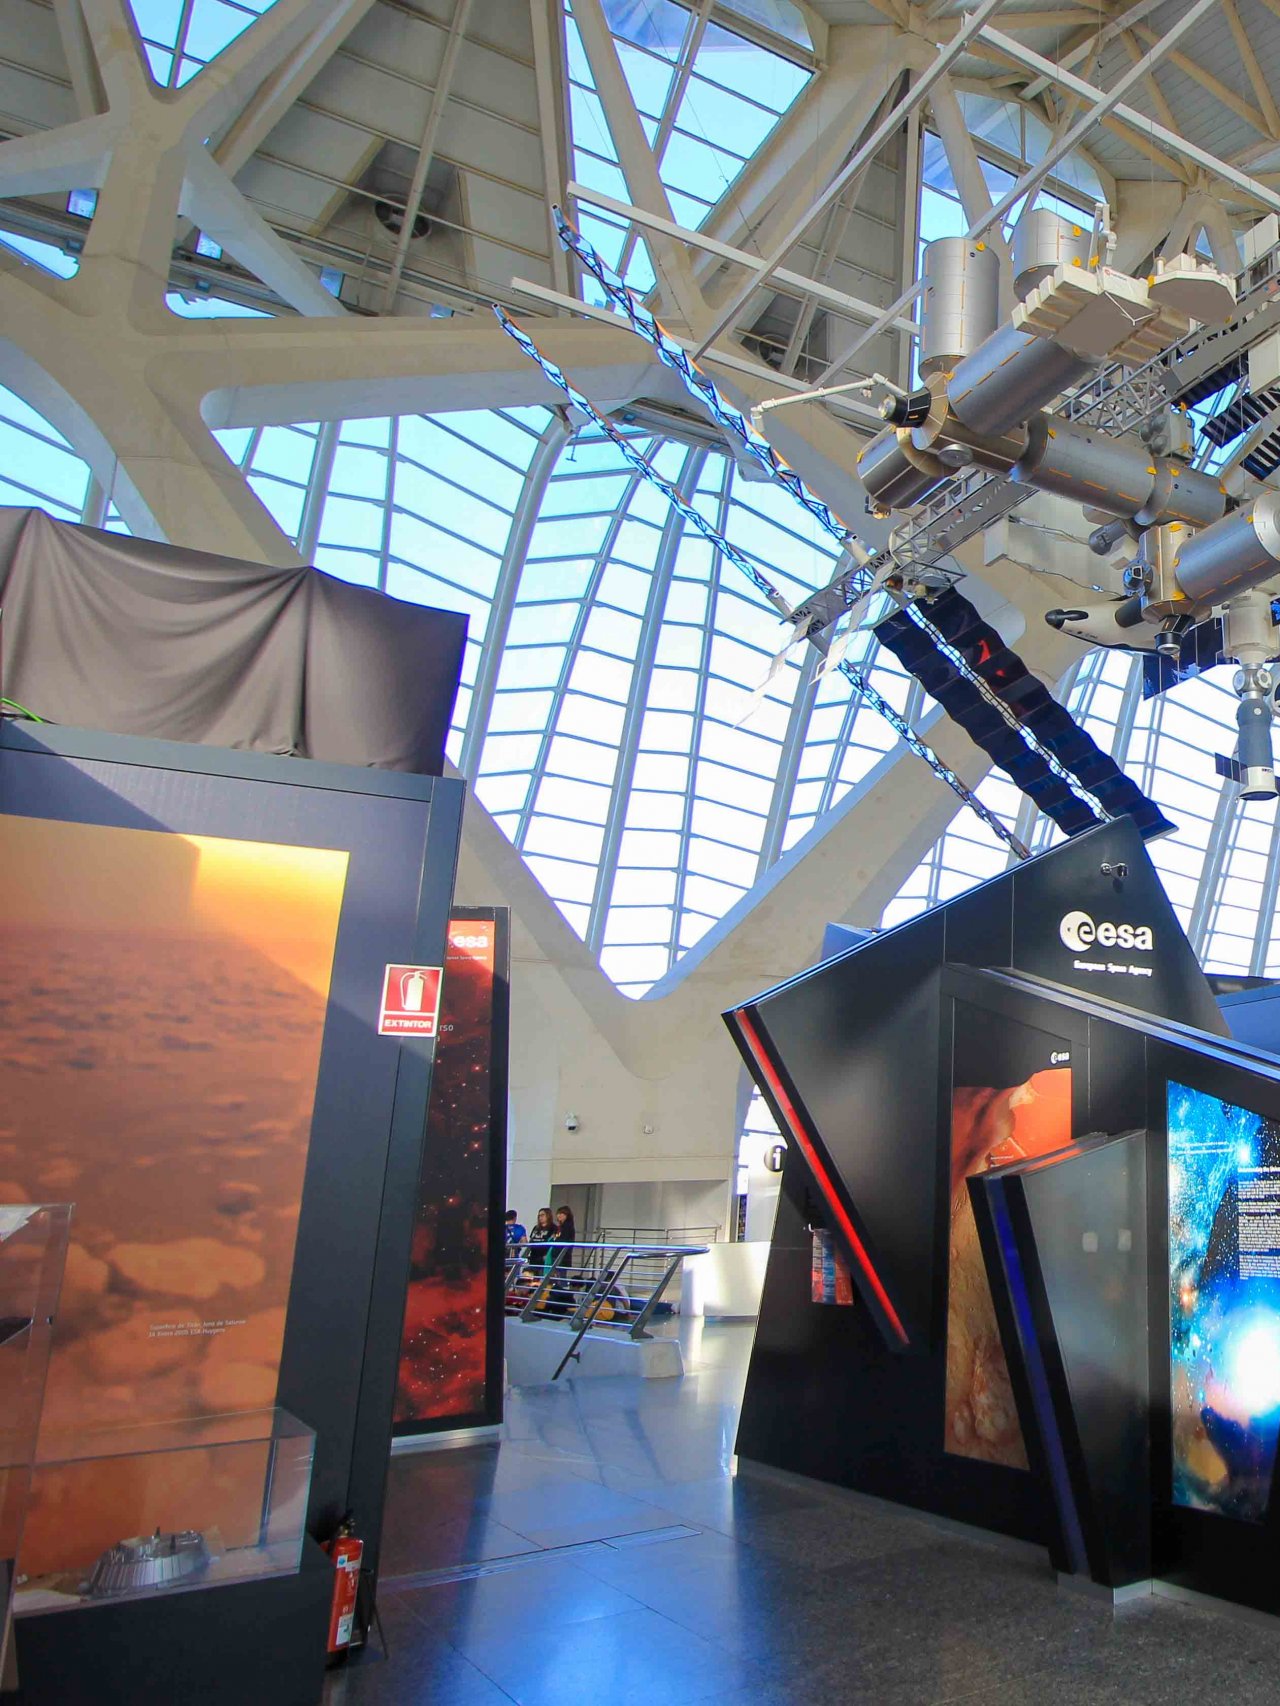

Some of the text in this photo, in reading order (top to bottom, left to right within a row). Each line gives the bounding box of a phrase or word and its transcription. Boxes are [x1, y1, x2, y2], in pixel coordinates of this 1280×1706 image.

[453, 935, 488, 948] esa
[1097, 922, 1153, 950] esa
[384, 1018, 432, 1029] EXTINTOR
